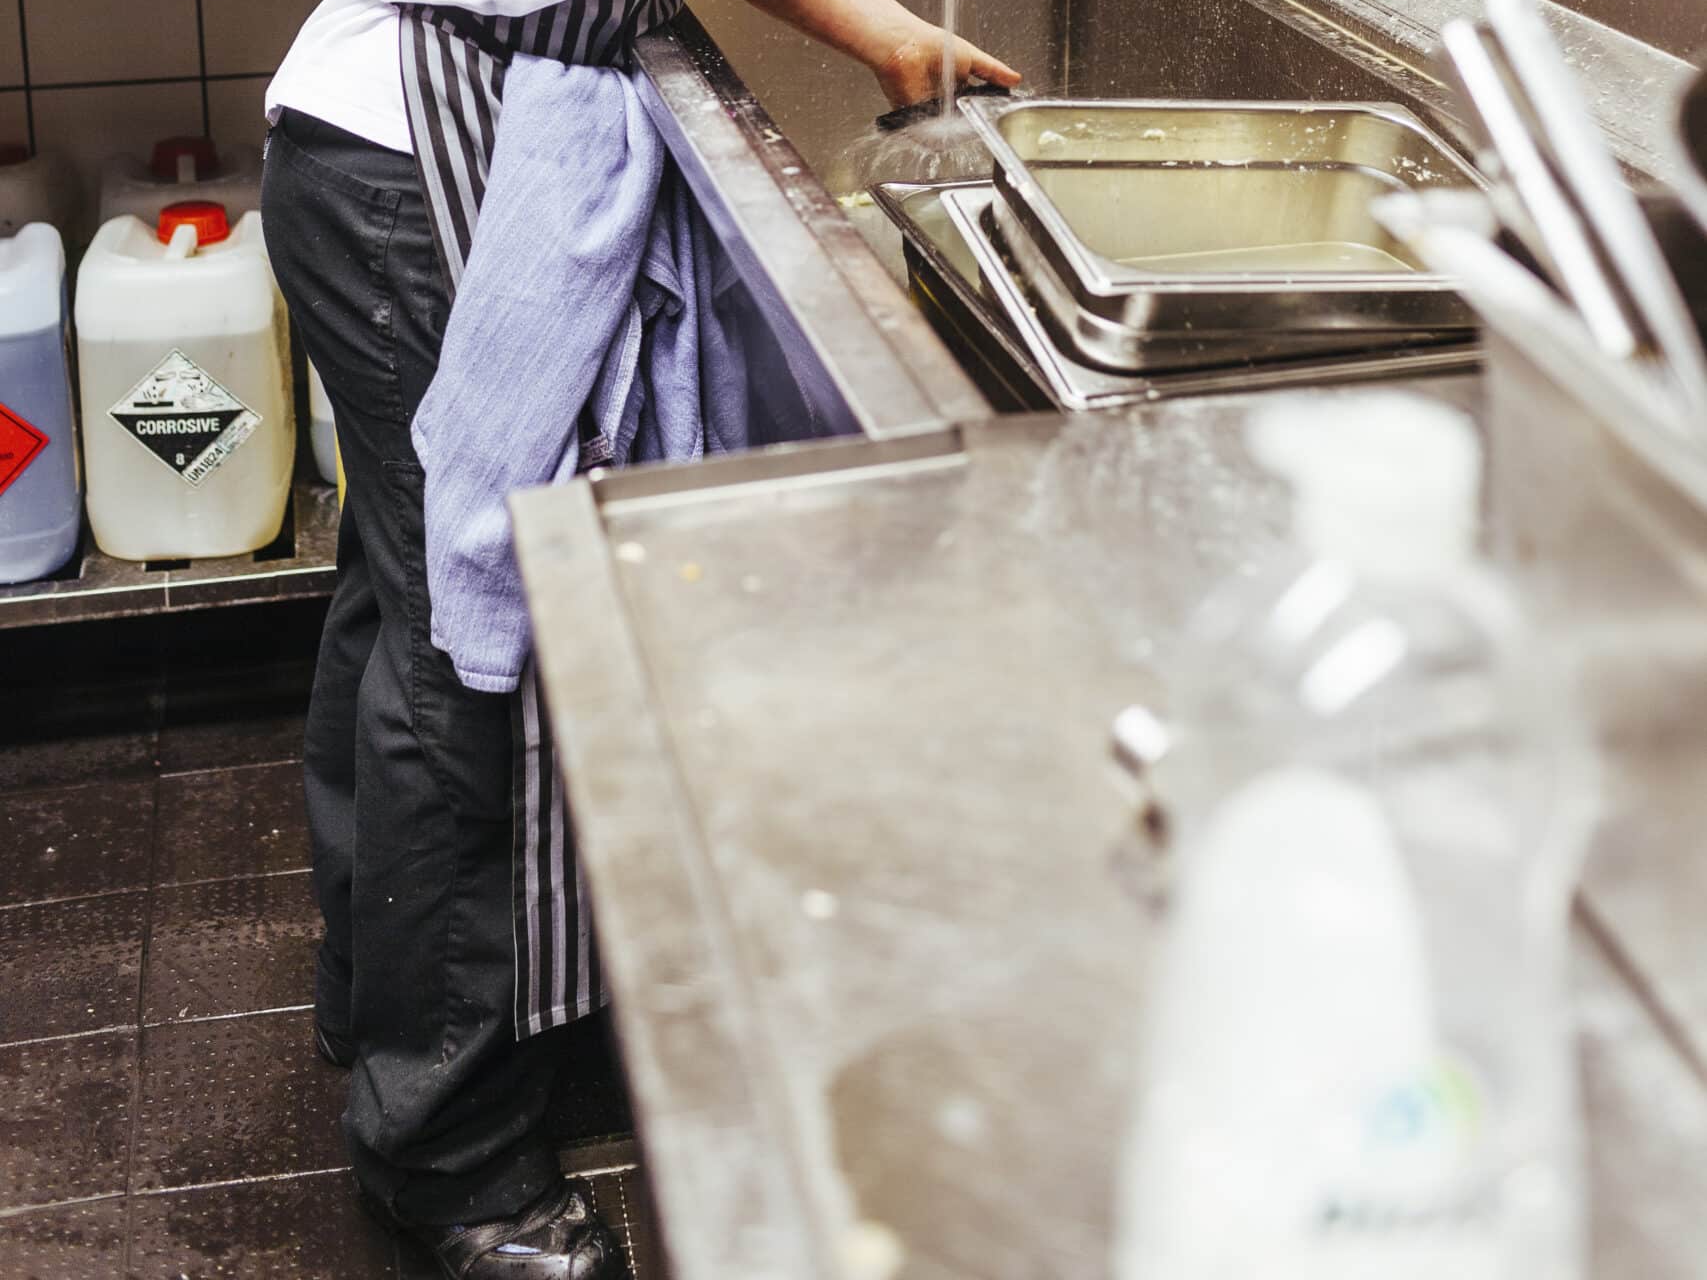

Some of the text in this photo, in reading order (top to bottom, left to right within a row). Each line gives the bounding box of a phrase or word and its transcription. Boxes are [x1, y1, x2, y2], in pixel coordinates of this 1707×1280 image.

[136, 418, 221, 435] CORROSIVE
[175, 452, 185, 466] 8
[187, 447, 223, 481] UN1824
